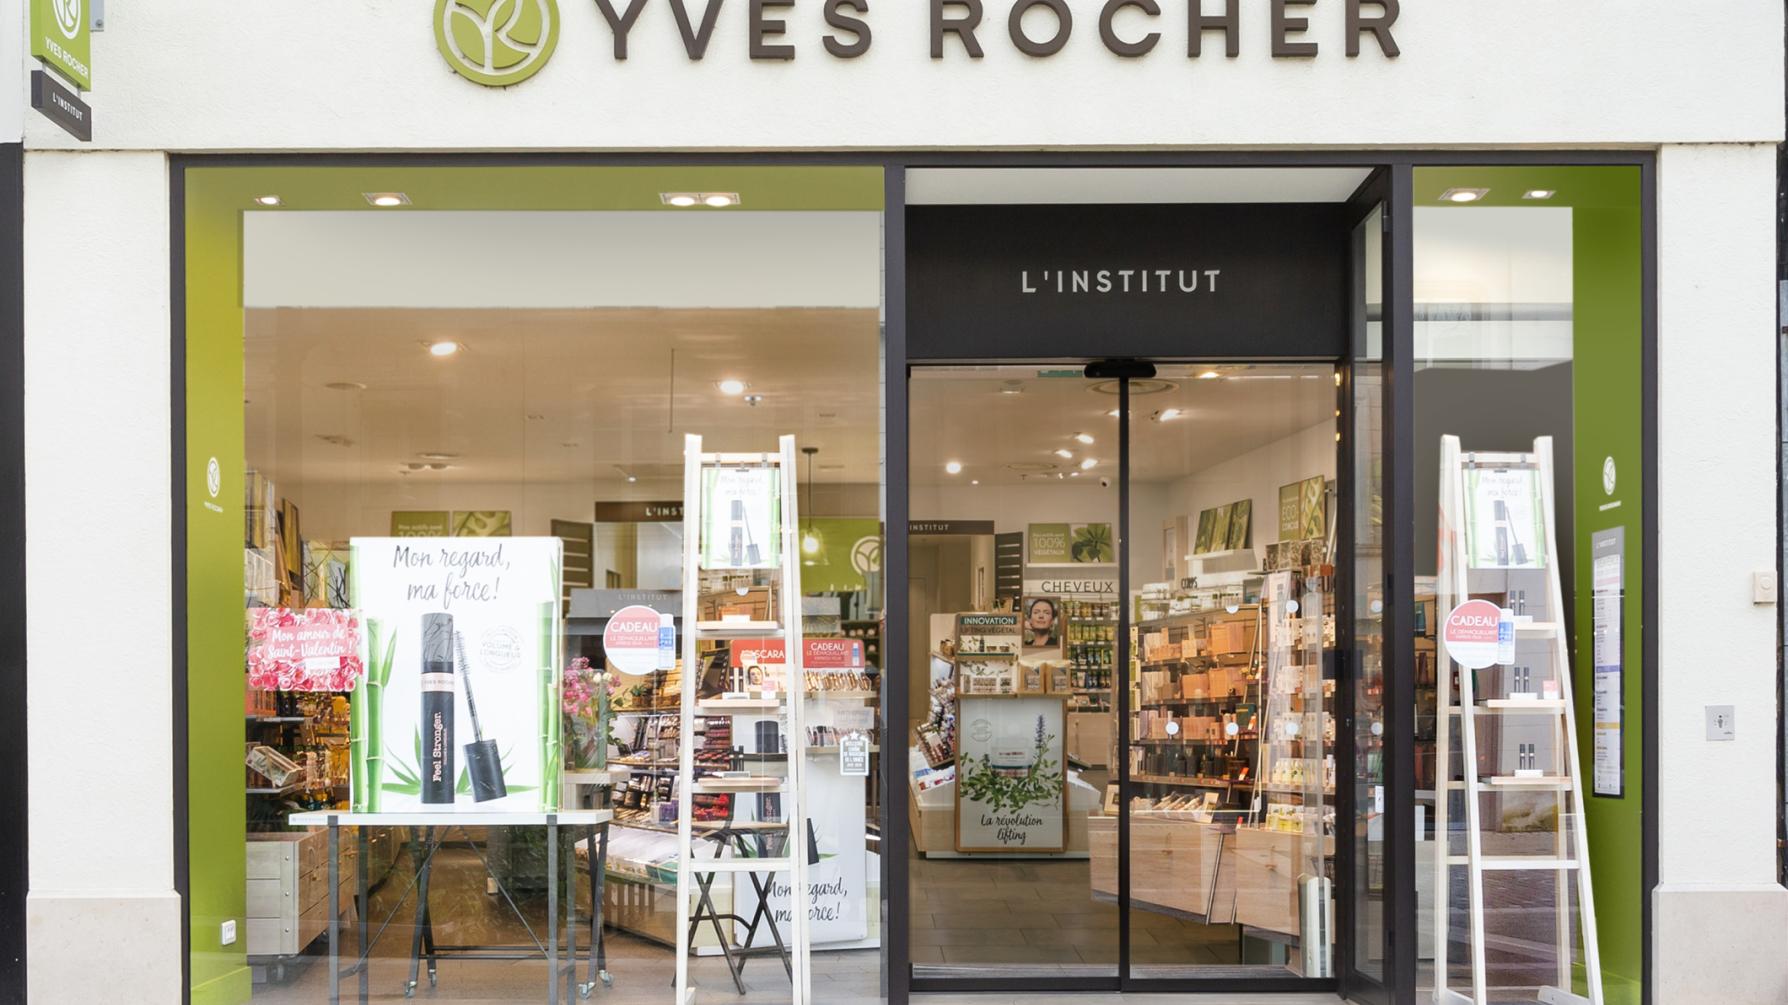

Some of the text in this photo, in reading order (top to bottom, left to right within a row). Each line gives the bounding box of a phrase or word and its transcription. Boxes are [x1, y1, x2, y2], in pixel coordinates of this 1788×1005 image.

[597, 0, 1401, 60] YVES ROCHER
[45, 36, 89, 79] YVES ROCHER
[52, 92, 83, 121] L'INSTITUT
[1021, 269, 1222, 293] L'INSTITUT
[645, 507, 684, 517] L'INST
[909, 524, 949, 532] INSTITUT
[393, 543, 511, 578] Mon regard,
[407, 572, 500, 610] ma force!
[1041, 581, 1114, 593] CHEVEUX
[610, 622, 658, 633] CADEAU
[964, 616, 1015, 625] INNOVATION
[1451, 615, 1498, 627] CADEAU
[272, 629, 295, 642] Mon
[746, 649, 785, 659] SCARA
[810, 642, 845, 651] CADEAU
[433, 760, 442, 783] Feel
[981, 813, 1043, 827] La révolution
[997, 828, 1026, 845] lifting
[807, 876, 848, 904] egard,
[808, 901, 841, 921] orce!
